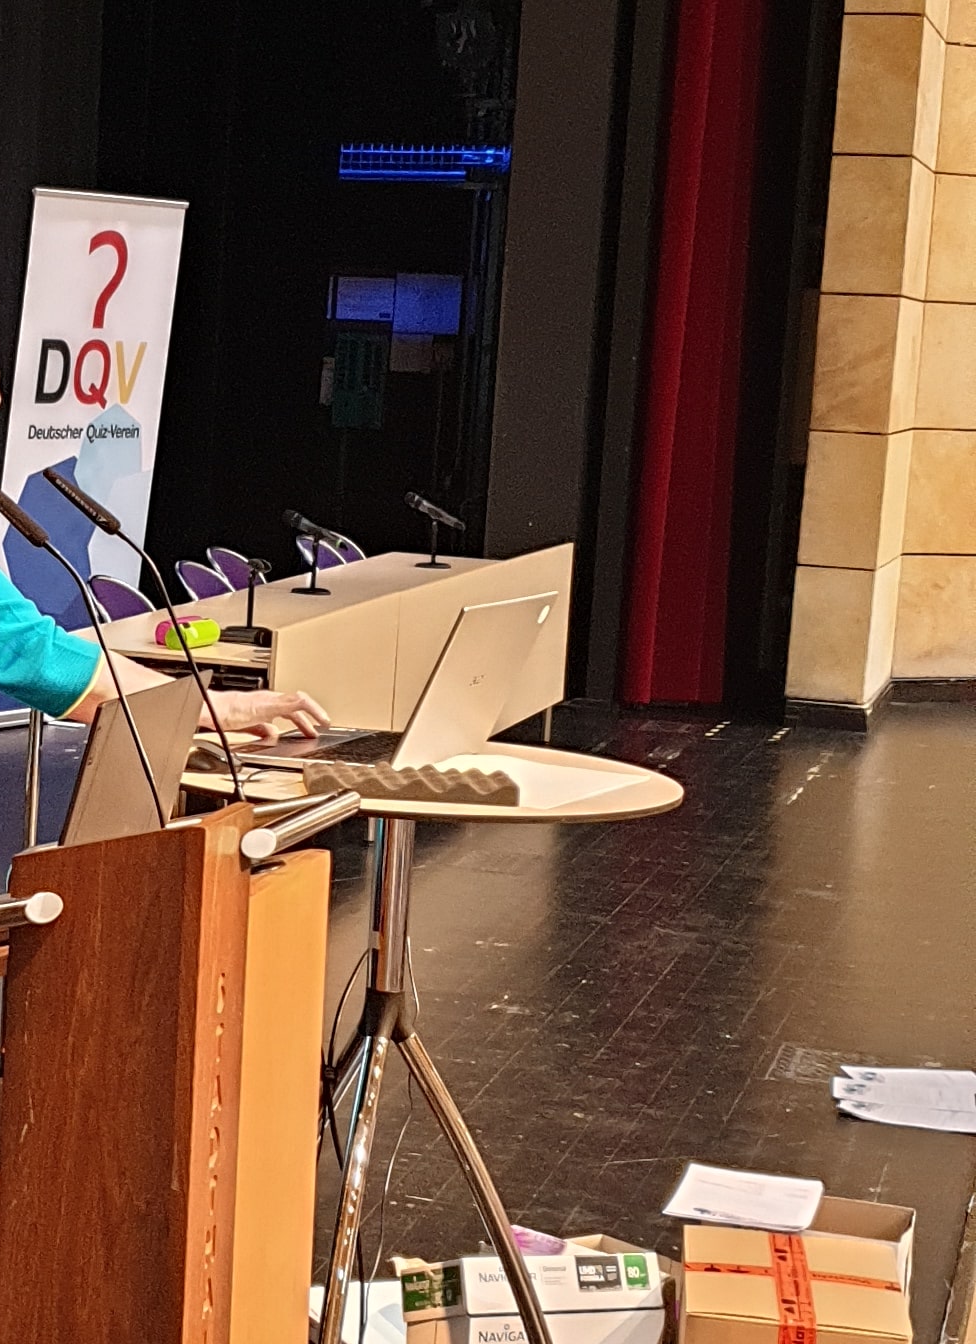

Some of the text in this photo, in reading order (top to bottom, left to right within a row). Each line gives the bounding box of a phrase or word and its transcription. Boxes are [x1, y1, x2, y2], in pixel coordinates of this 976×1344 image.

[34, 338, 148, 410] DQV
[27, 423, 140, 444] Deutscher Quiz-Verein
[478, 1330, 525, 1344] NAVIGA
